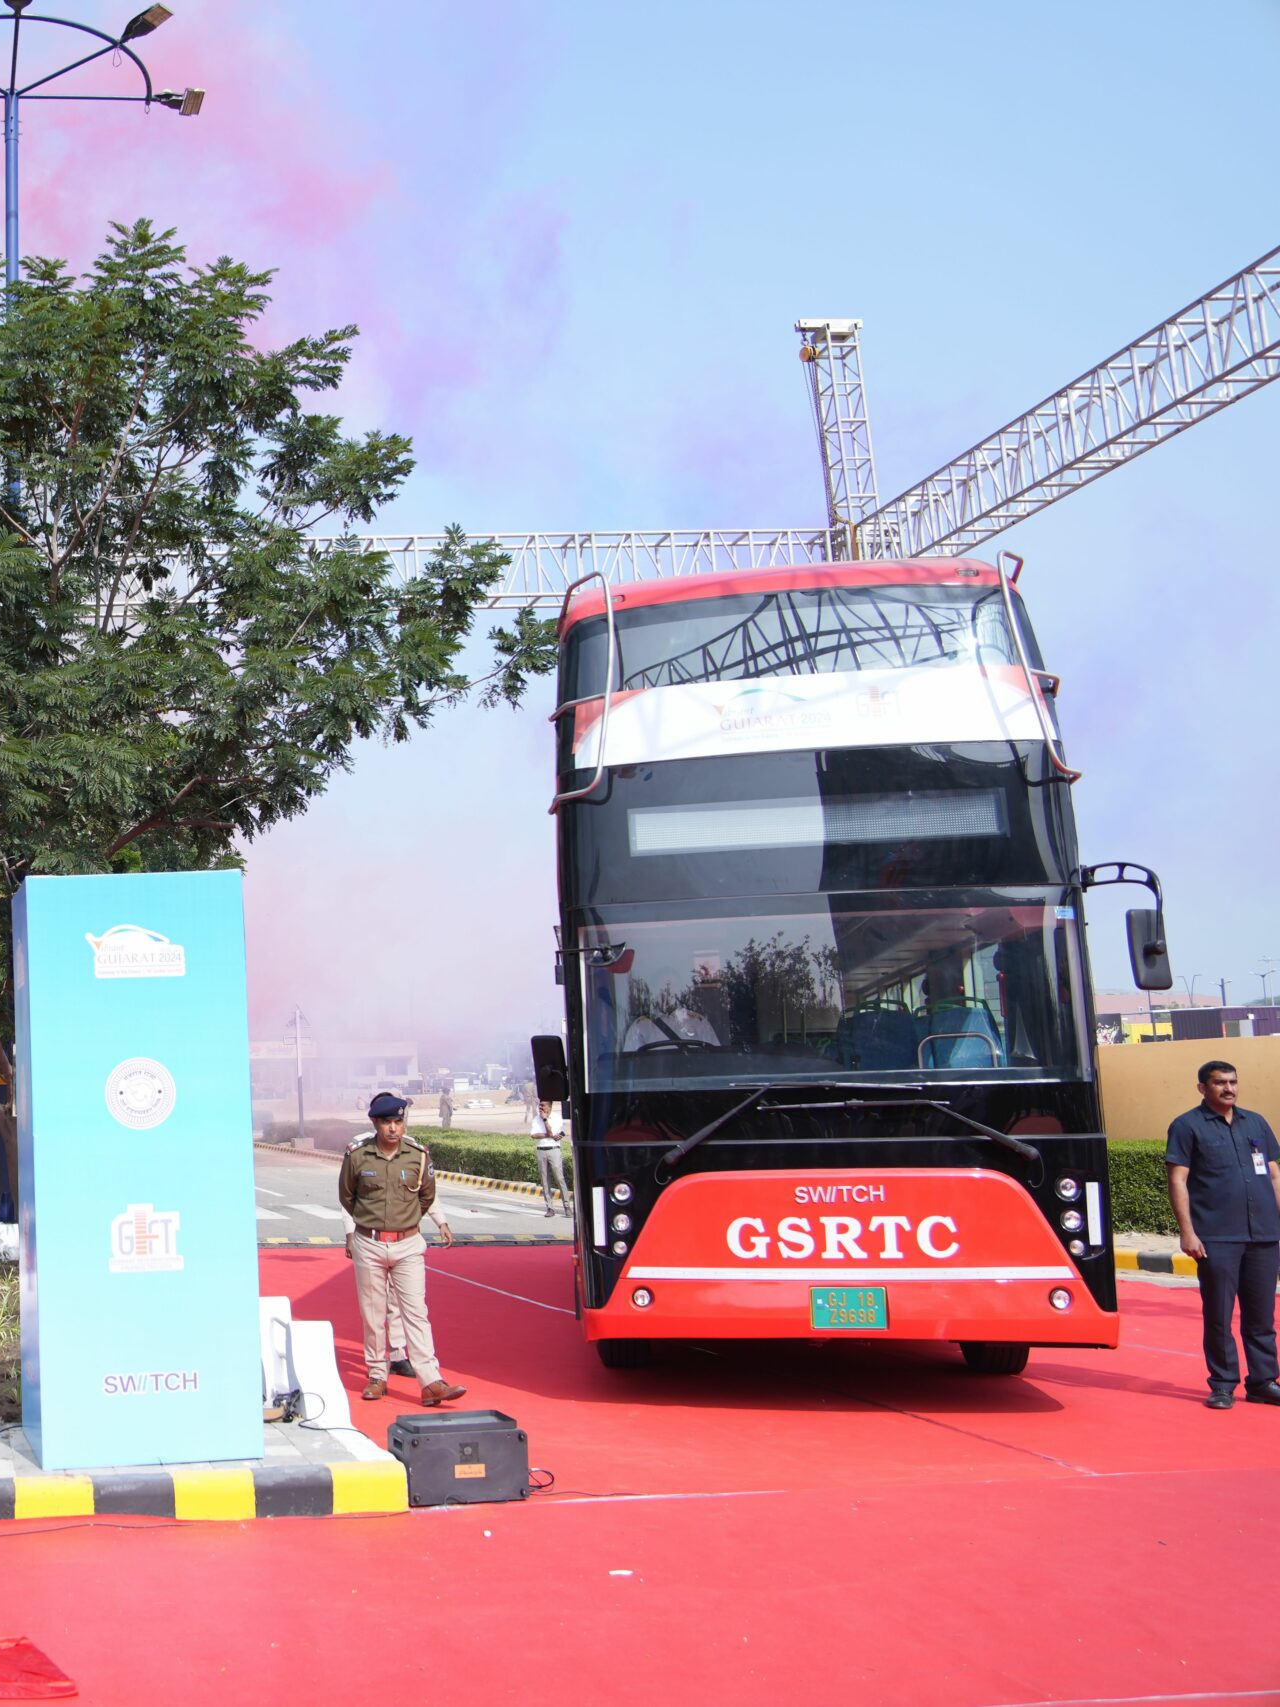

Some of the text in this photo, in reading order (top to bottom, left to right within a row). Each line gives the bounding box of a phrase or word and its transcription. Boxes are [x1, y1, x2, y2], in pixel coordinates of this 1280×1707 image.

[96, 952, 182, 965] GUJARAT 2024
[726, 1215, 960, 1260] GSRTC
[828, 1291, 875, 1307] GJ 18
[829, 1308, 877, 1325] Z9698
